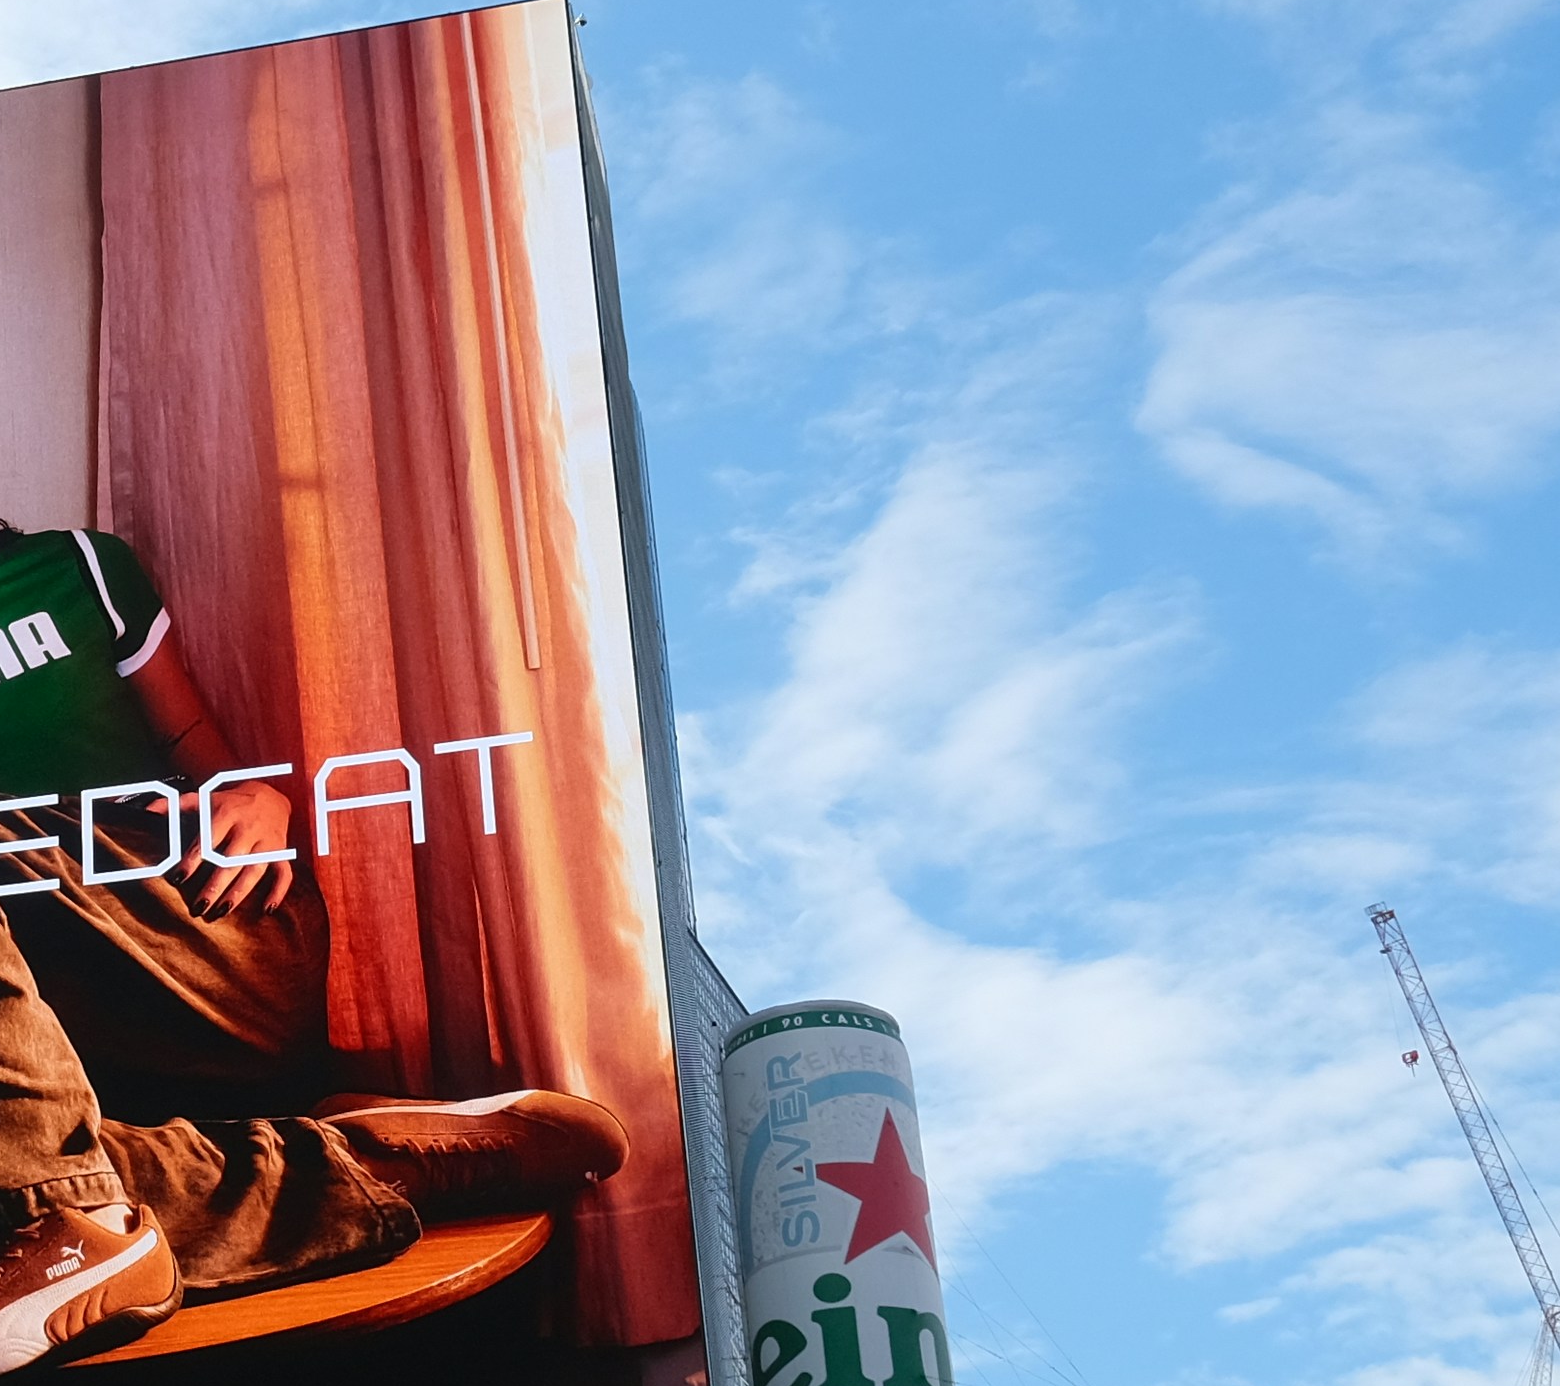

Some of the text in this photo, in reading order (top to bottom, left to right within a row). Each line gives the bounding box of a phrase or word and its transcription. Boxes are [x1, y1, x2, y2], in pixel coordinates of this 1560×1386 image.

[781, 1013, 874, 1029] 90 CALS
[766, 1050, 821, 1247] SILVER
[45, 1256, 81, 1281] PUMA
